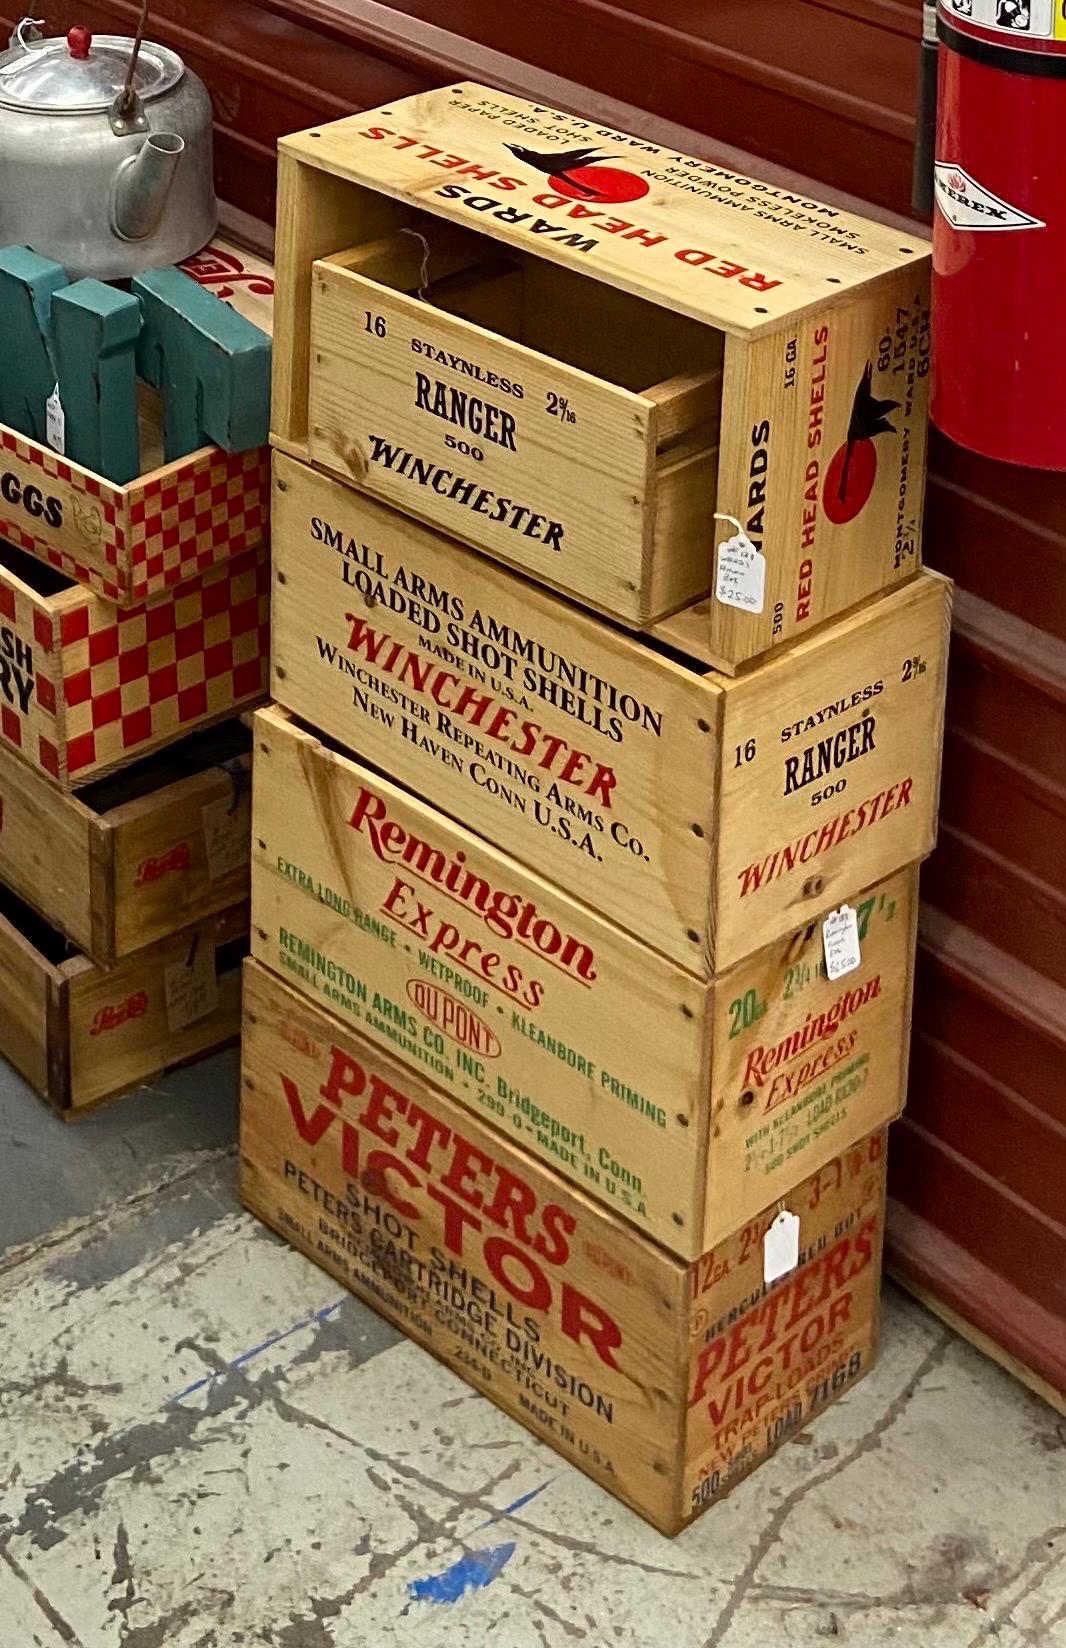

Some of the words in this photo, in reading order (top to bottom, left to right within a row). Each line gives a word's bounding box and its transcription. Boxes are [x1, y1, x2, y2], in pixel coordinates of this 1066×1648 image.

[448, 99, 500, 119] PAPER
[477, 100, 539, 123] SHELLS
[502, 119, 569, 144] LOADED
[543, 124, 592, 141] SHOT
[596, 130, 660, 154] WARD
[358, 127, 526, 190] SHELLS
[640, 169, 754, 210] AMMUNITION
[664, 166, 744, 196] POWDER
[667, 154, 839, 218] MONTGOMERY
[434, 184, 598, 251] WARDS
[532, 193, 667, 246] HEAD
[745, 196, 860, 238] SMOKELESS
[753, 210, 806, 230] ARMS
[810, 229, 868, 254] SMALL
[674, 249, 782, 291] RED
[364, 311, 385, 337] 16
[411, 338, 523, 398] STAYNLESS
[783, 366, 795, 388] 16
[807, 325, 828, 448] SHELLS
[415, 372, 515, 450] RANGER
[444, 433, 483, 461] 500
[1, 472, 63, 529] GGS
[369, 435, 563, 550] WINCHESTER
[893, 427, 910, 568] MONTGOMERY
[904, 356, 915, 417] WARD
[801, 460, 818, 548] HEAD
[311, 517, 388, 579] SMALL
[393, 566, 463, 620] ARMS
[470, 610, 661, 735] AMMUNITION
[772, 602, 783, 635] 500
[795, 559, 812, 621] RED
[1, 626, 33, 676] SH
[342, 560, 440, 633] LOADED
[446, 622, 516, 680] SHOT
[523, 667, 622, 742] SHELLS
[418, 634, 463, 668] MADE
[469, 663, 485, 683] IN
[490, 676, 533, 712] U.S.A.
[345, 613, 615, 807] WINCHESTER
[734, 738, 755, 768] 16
[781, 680, 883, 742] STAYNLESS
[784, 717, 875, 795] RANGER
[811, 778, 846, 806] 500
[534, 799, 602, 861] U.S.A.
[738, 777, 912, 896] WINCHESTER
[348, 787, 594, 986] Remington
[279, 926, 366, 1002] REMINGTON
[372, 992, 417, 1036] ARMS
[380, 877, 543, 1010] Express
[277, 856, 313, 893] EXTRA
[318, 883, 350, 917] LONG
[354, 906, 396, 948] RANGE
[418, 949, 488, 1007] WETPROOF
[511, 1011, 594, 1079] KLEANBORE
[601, 1071, 666, 1128] PRIMING
[279, 951, 318, 989] SMALL
[323, 983, 360, 1016] ARMS
[365, 1011, 453, 1081] AMMUNITION
[536, 1129, 576, 1168] MADE
[583, 1162, 599, 1183] IN
[740, 975, 881, 1100] Remington
[764, 1029, 857, 1114] Express
[320, 1047, 575, 1264] PETERS
[281, 1075, 621, 1370] VICTOR
[284, 1159, 362, 1234] PETERS
[369, 1228, 495, 1336] CARTRIDGE
[506, 1328, 612, 1423] DIVISION
[346, 1182, 419, 1250] SHOT
[430, 1246, 539, 1342] SHELLS
[687, 1215, 876, 1406] PETERS
[435, 1308, 568, 1415] CONNECTICUT
[708, 1291, 852, 1425] VICTOR
